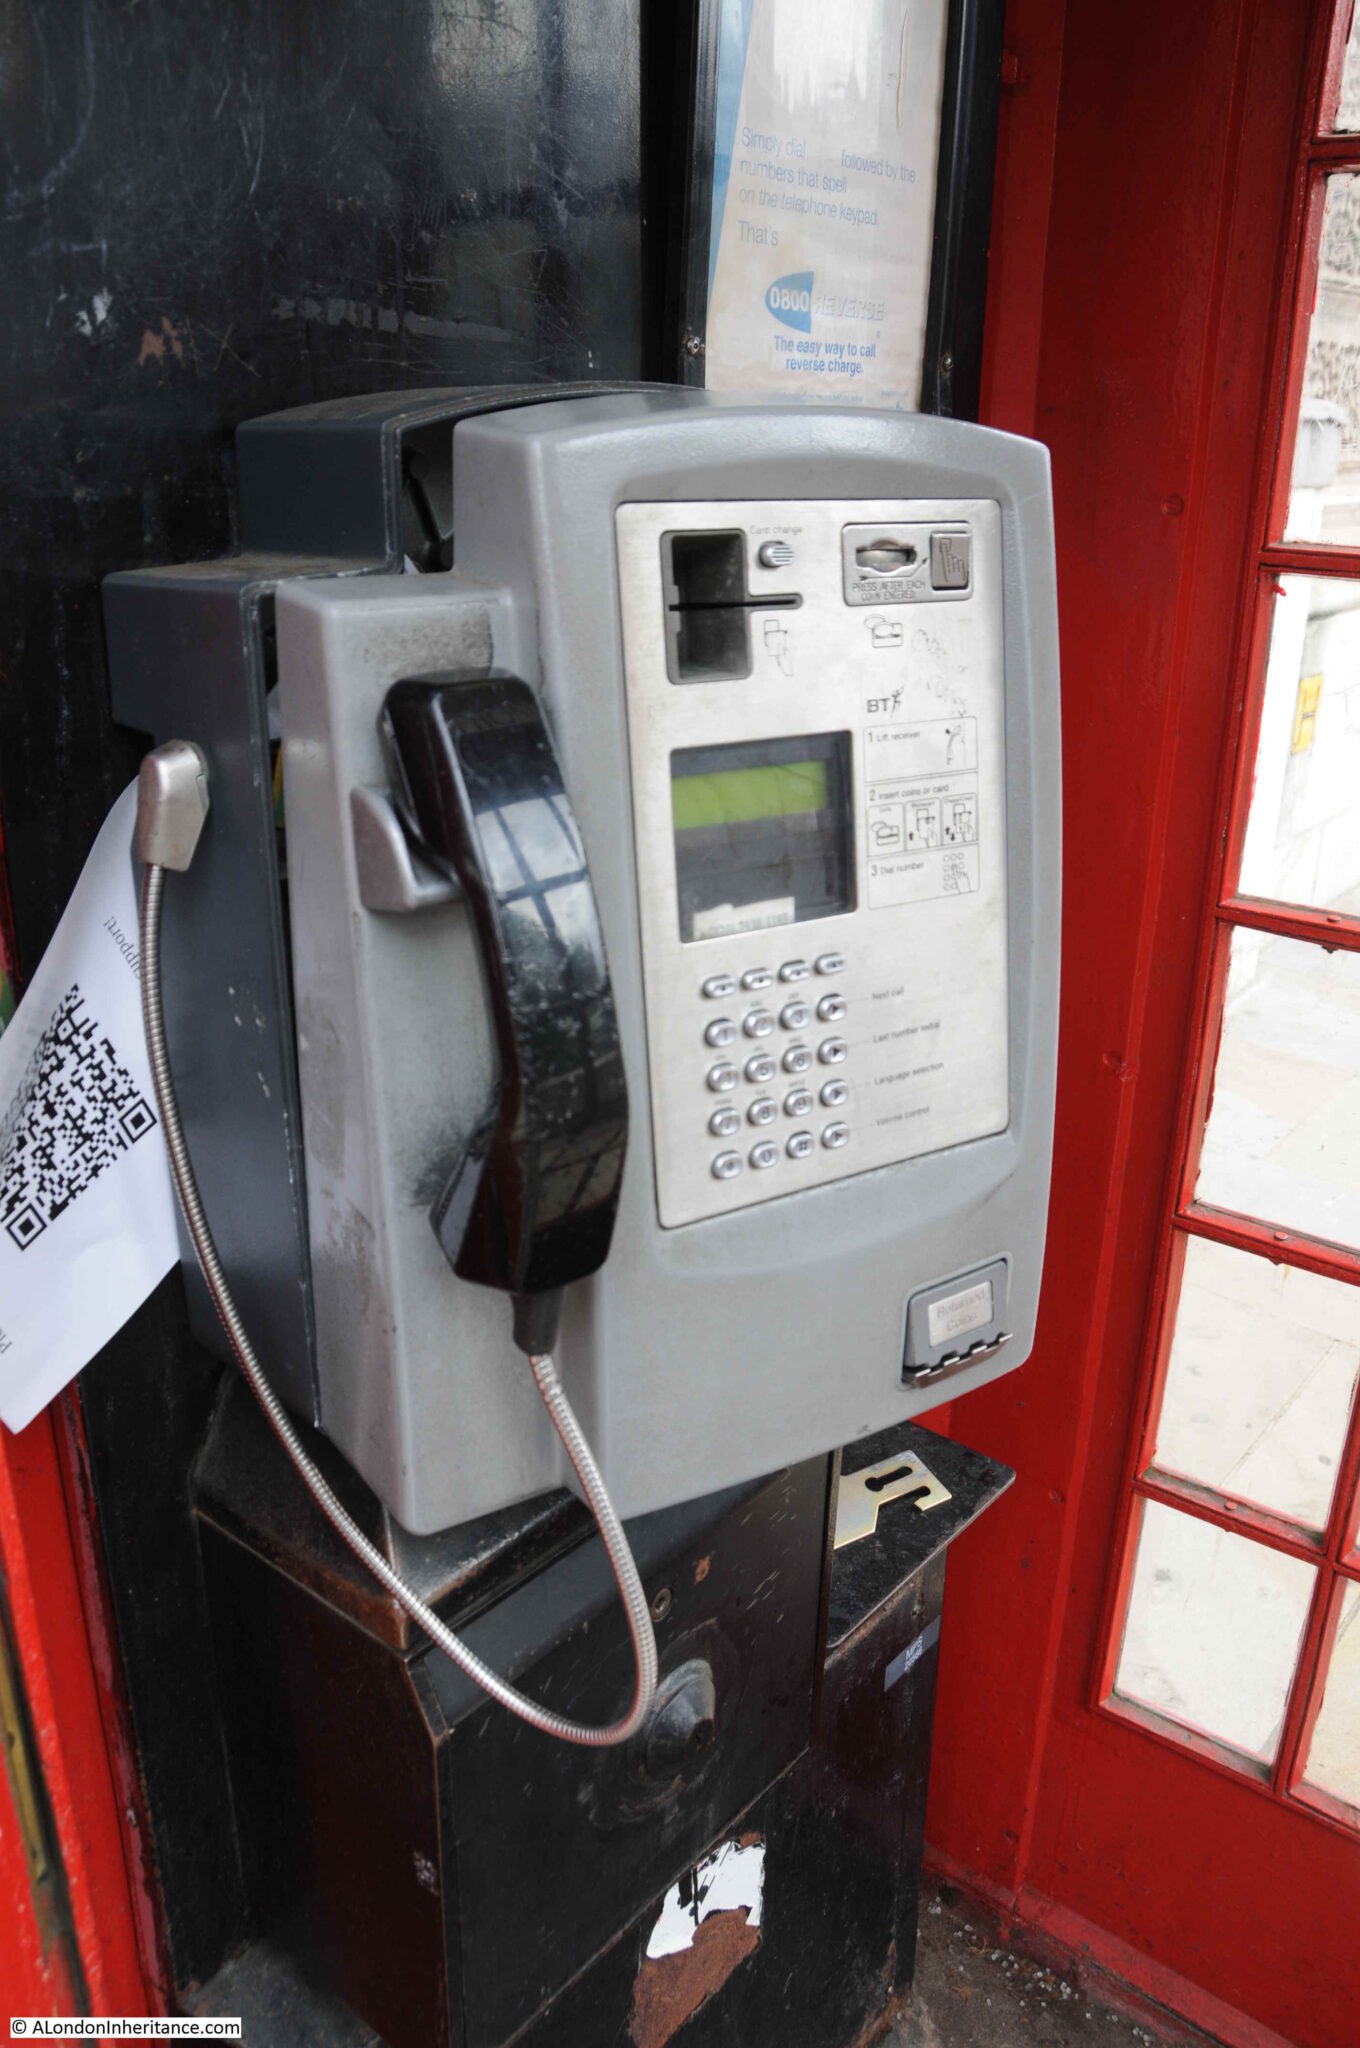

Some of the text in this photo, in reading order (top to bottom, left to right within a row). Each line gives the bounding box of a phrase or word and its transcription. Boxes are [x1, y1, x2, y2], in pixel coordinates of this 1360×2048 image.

[742, 127, 916, 183] Simply dial followed by the
[740, 159, 848, 196] numbers that spell
[738, 187, 755, 203] on
[759, 188, 777, 208] the
[781, 193, 837, 219] telephone
[738, 220, 778, 247] That's
[769, 287, 809, 312] 0800
[774, 335, 876, 359] The easy way to call
[786, 357, 864, 377] reverse charge.
[852, 579, 927, 592] PRESS AFTER EACH
[867, 698, 891, 713] BT
[868, 731, 873, 742] 1
[869, 789, 876, 801] 2
[871, 864, 878, 877] 3
[896, 862, 925, 872] number
